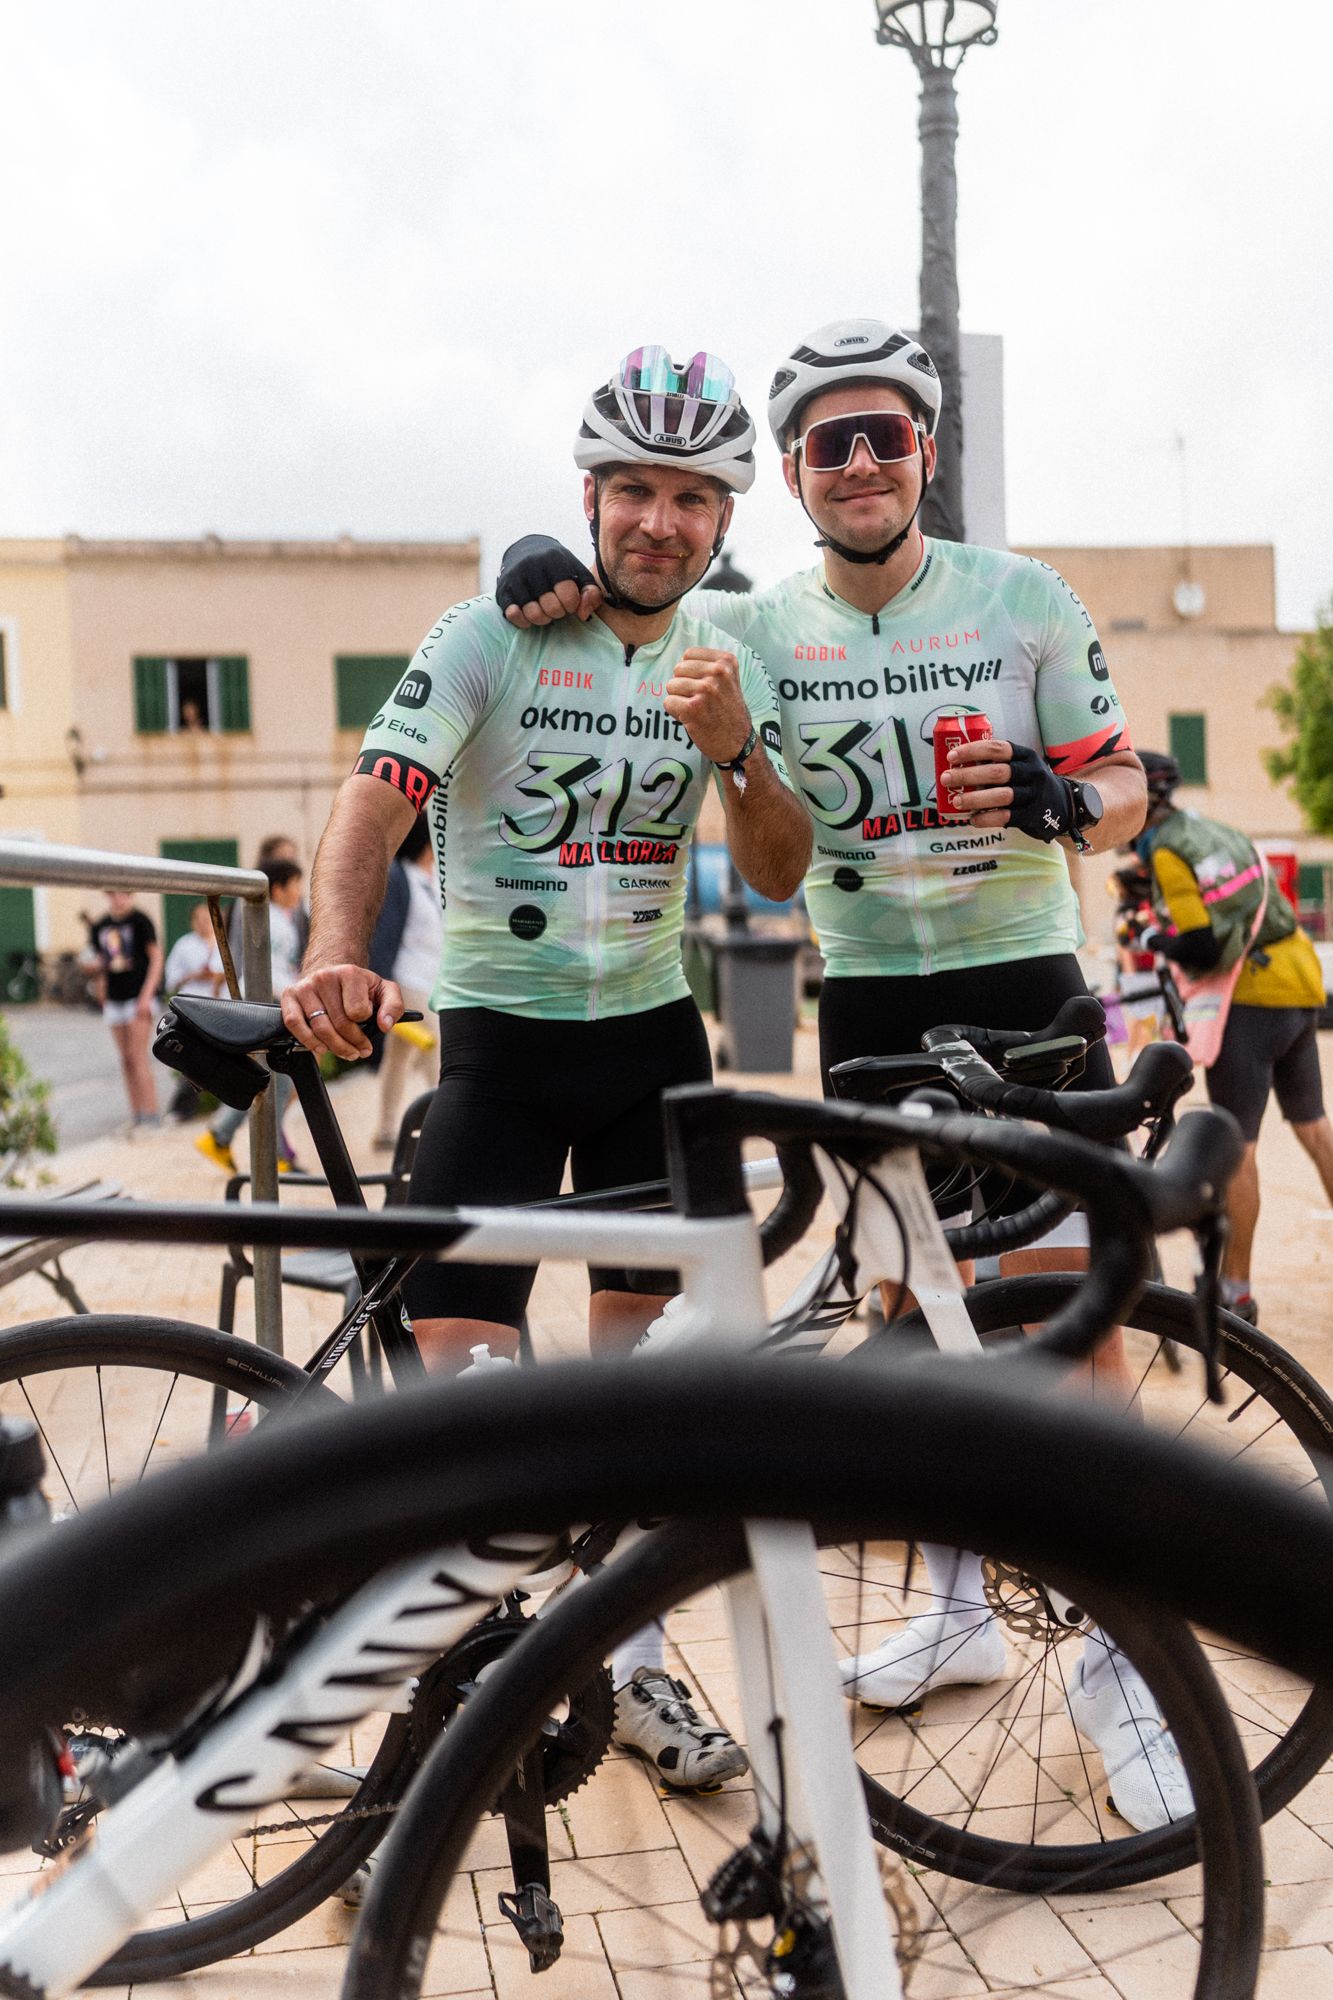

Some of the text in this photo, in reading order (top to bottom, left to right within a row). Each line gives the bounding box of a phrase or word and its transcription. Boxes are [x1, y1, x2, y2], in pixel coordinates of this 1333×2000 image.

[659, 436, 683, 445] ABUS
[795, 645, 848, 661] GOBIK
[891, 628, 981, 655] AURUM
[539, 668, 594, 690] GOBIK
[387, 719, 428, 744] Eide
[498, 750, 694, 855] 312
[558, 839, 680, 869] MALLORCA
[817, 845, 877, 861] SHIMANO
[495, 876, 568, 892] SHIMANO
[321, 1322, 362, 1370] ULTIMATE
[357, 1311, 371, 1328] CF
